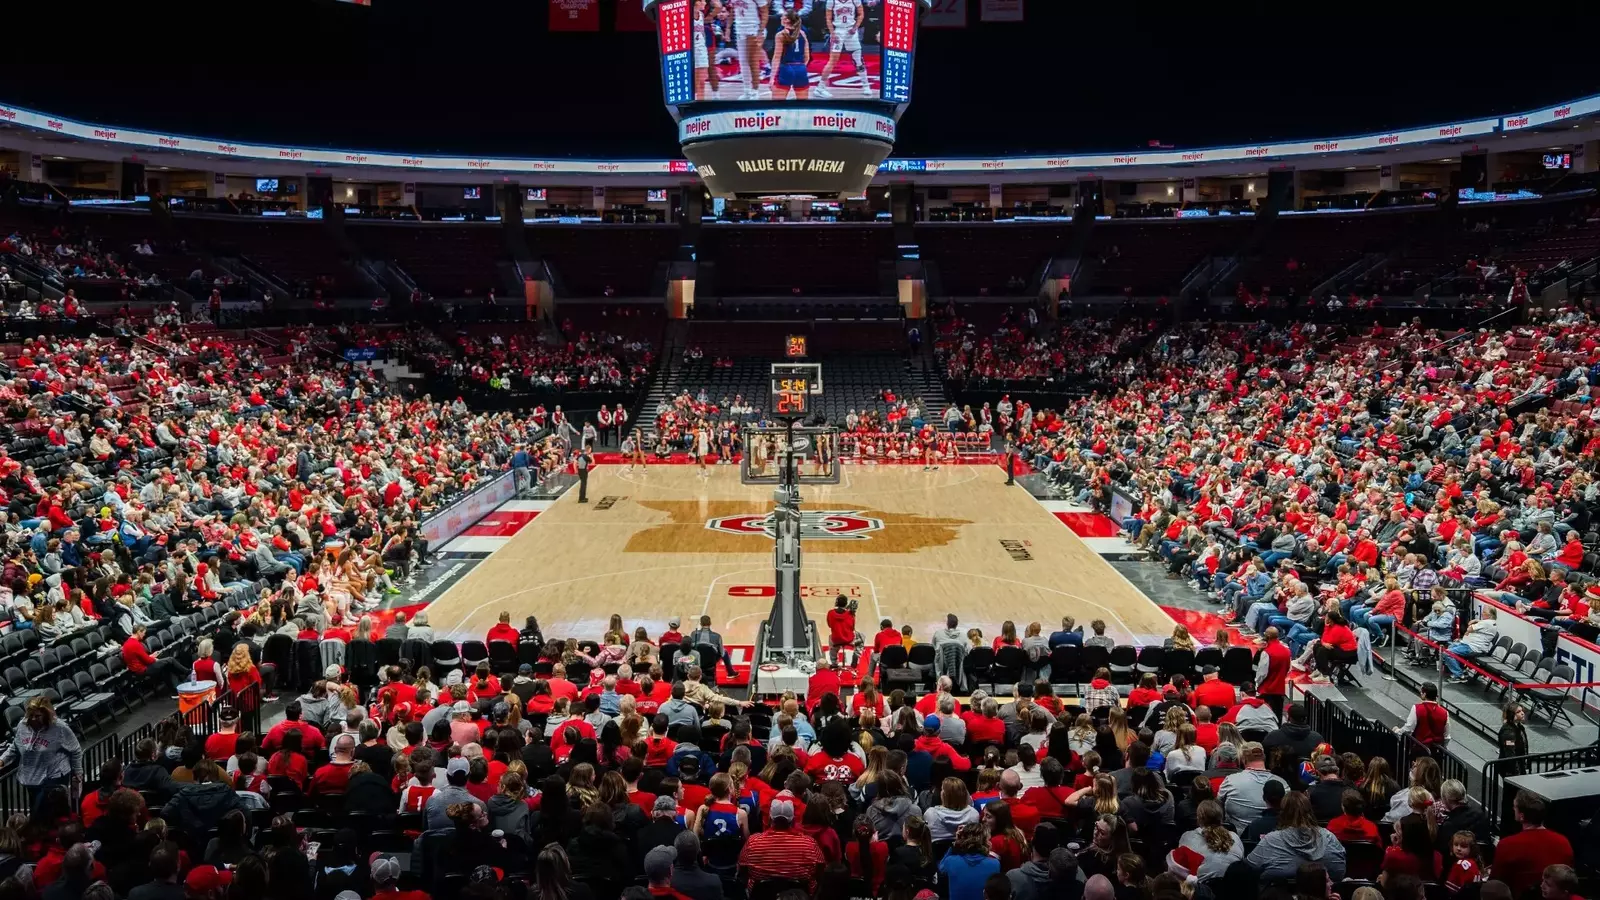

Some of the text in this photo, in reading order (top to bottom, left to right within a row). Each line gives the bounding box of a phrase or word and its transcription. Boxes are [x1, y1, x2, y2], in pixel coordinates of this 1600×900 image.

[667, 52, 688, 60] BELMONT
[888, 50, 908, 58] BELMONT
[0, 108, 16, 120] meijer
[1554, 105, 1571, 118] meijer
[48, 119, 63, 131] meijer
[734, 112, 781, 129] meijer
[813, 112, 856, 130] meijer
[1507, 116, 1528, 128] meijer
[686, 118, 711, 135] meijer
[876, 119, 893, 135] meijer
[1439, 125, 1462, 136] meijer
[94, 128, 116, 139] meijer
[159, 137, 180, 147] meijer
[1379, 134, 1399, 144] meijer
[218, 144, 237, 154] meijer
[1314, 141, 1338, 151] meijer
[279, 150, 302, 159] meijer
[1182, 152, 1203, 161] meijer
[1246, 148, 1268, 156] meijer
[346, 154, 367, 163] meijer
[402, 156, 423, 166] meijer
[1047, 158, 1069, 167] meijer
[1114, 156, 1137, 164] meijer
[467, 160, 490, 168] meijer
[534, 161, 555, 170] meijer
[736, 159, 845, 173] VALUE CITY ARENA
[982, 160, 1004, 168] meijer
[790, 345, 802, 355] 24
[779, 393, 802, 412] 24
[417, 796, 422, 811] 1
